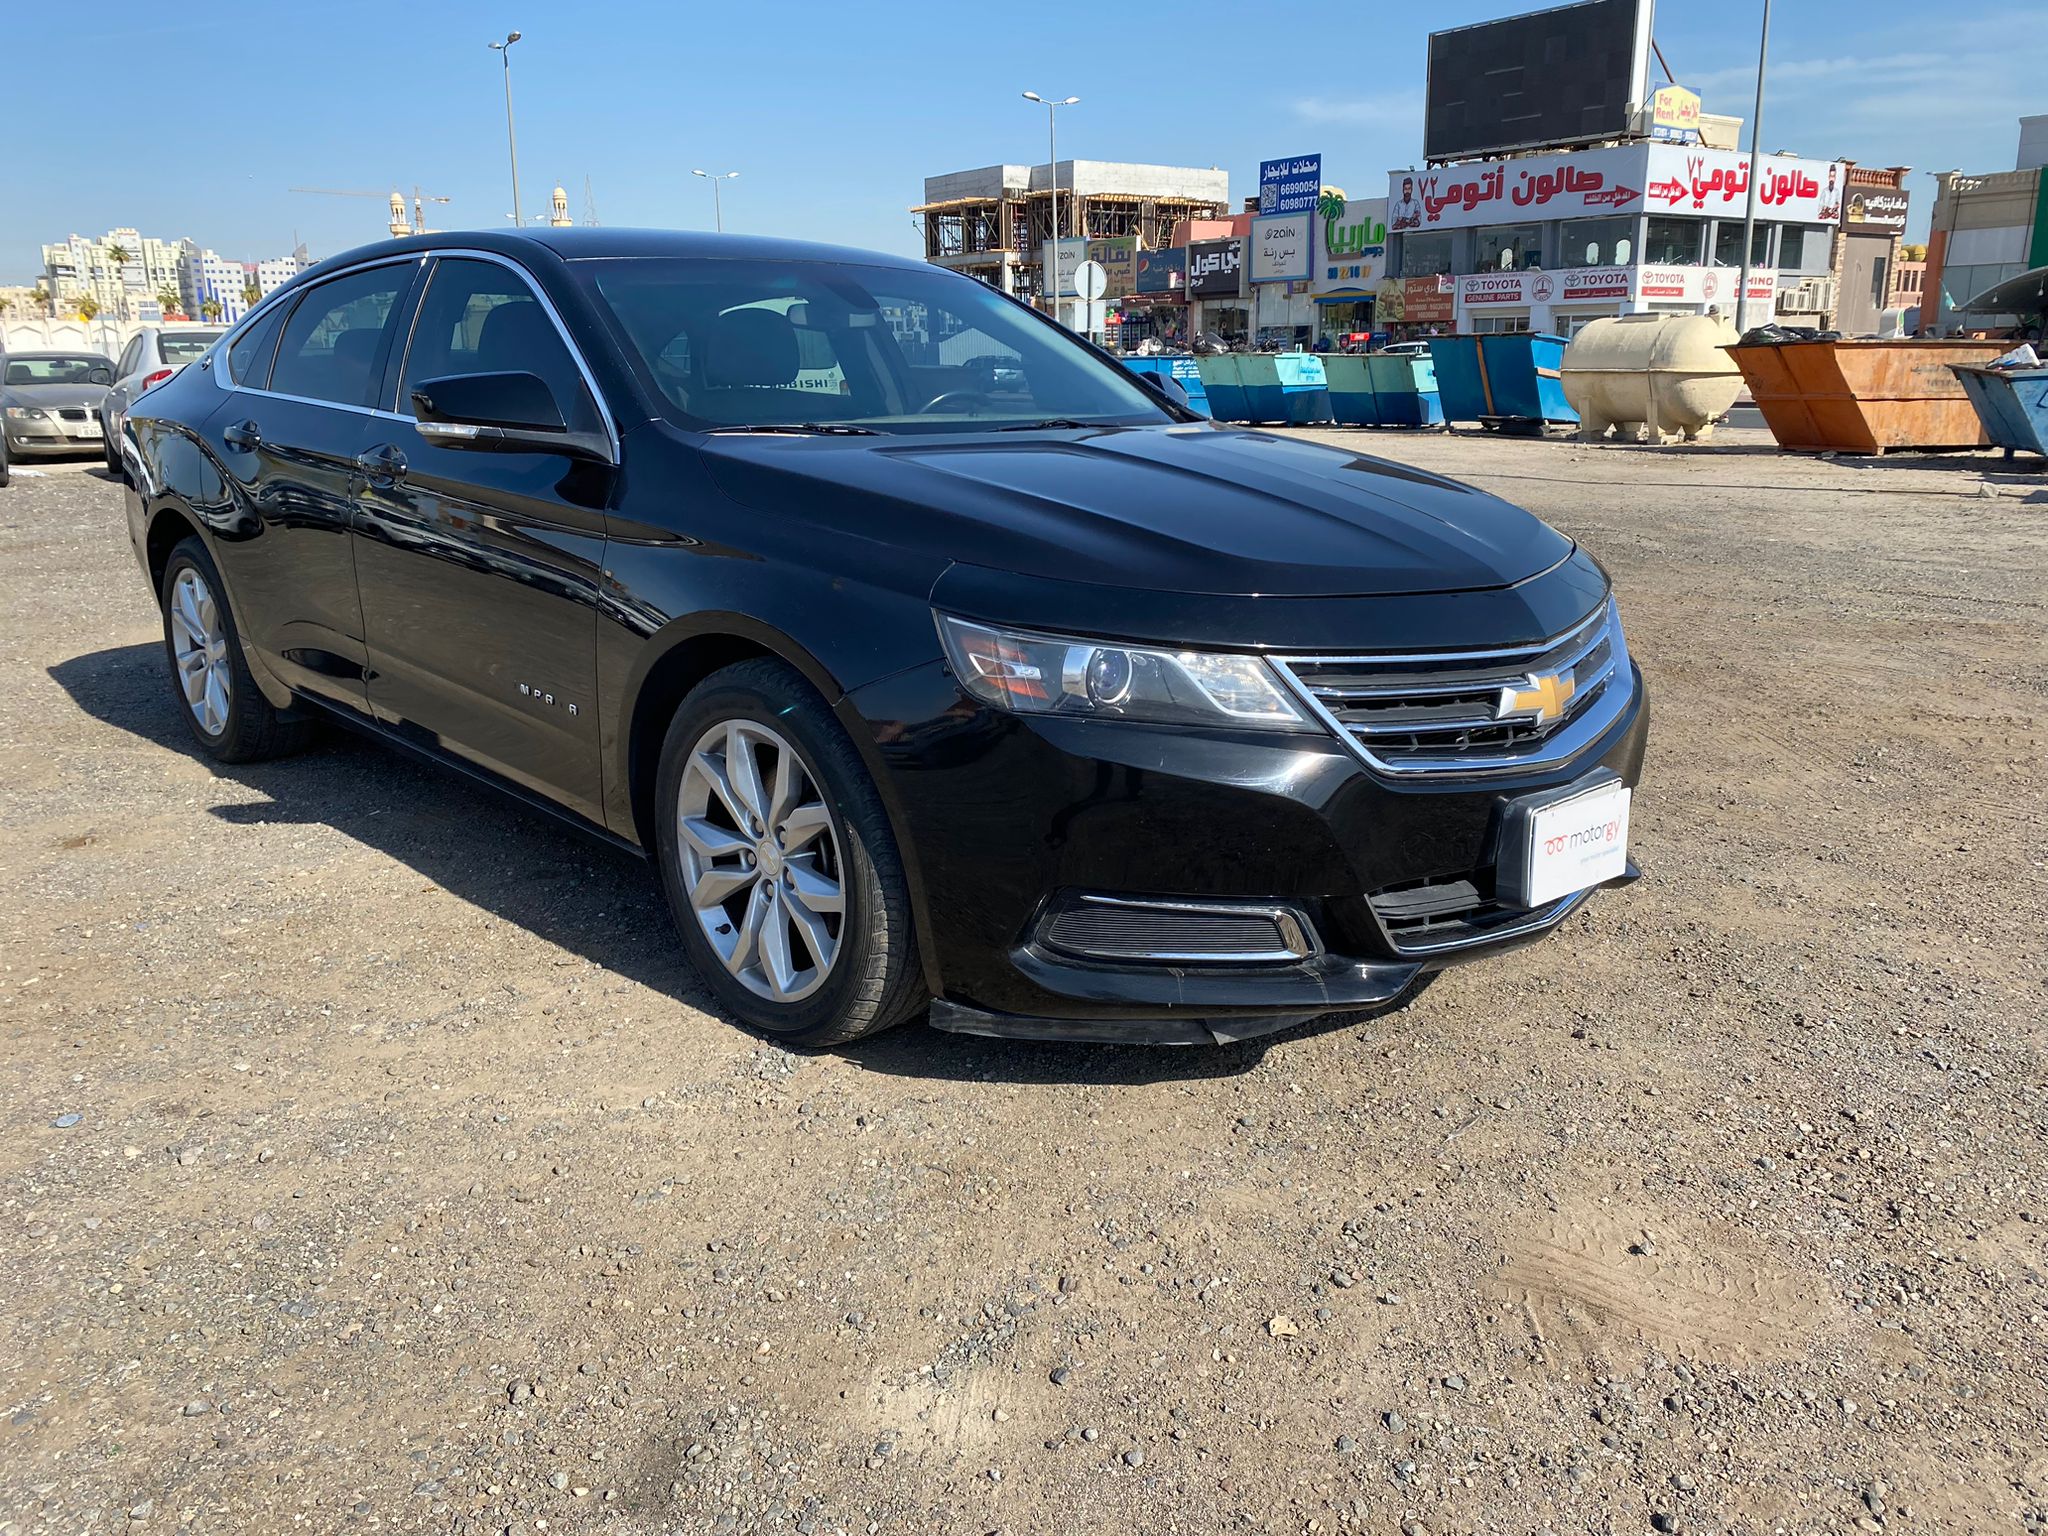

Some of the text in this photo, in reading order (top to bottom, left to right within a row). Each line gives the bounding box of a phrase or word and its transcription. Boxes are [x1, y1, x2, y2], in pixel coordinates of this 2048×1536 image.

[1659, 93, 1672, 106] For
[1656, 107, 1674, 120] Rent
[1292, 160, 1318, 175] محلات
[1280, 180, 1319, 195] 66990054
[1512, 166, 1603, 206] صالون
[1692, 161, 1749, 209] تومي
[1760, 167, 1819, 206] صالون
[1425, 166, 1505, 222] أتومي
[1280, 196, 1318, 211] 60980777
[1328, 216, 1386, 254] ماربيا
[1091, 246, 1131, 264] بقالة
[1481, 279, 1522, 290] TOYOTA
[1582, 273, 1629, 285] TOYOTA
[1654, 273, 1685, 284] TOYOTA
[1747, 276, 1774, 286] HINO
[1466, 292, 1519, 302] GENUINE PARTS
[1569, 820, 1621, 849] motorgy
